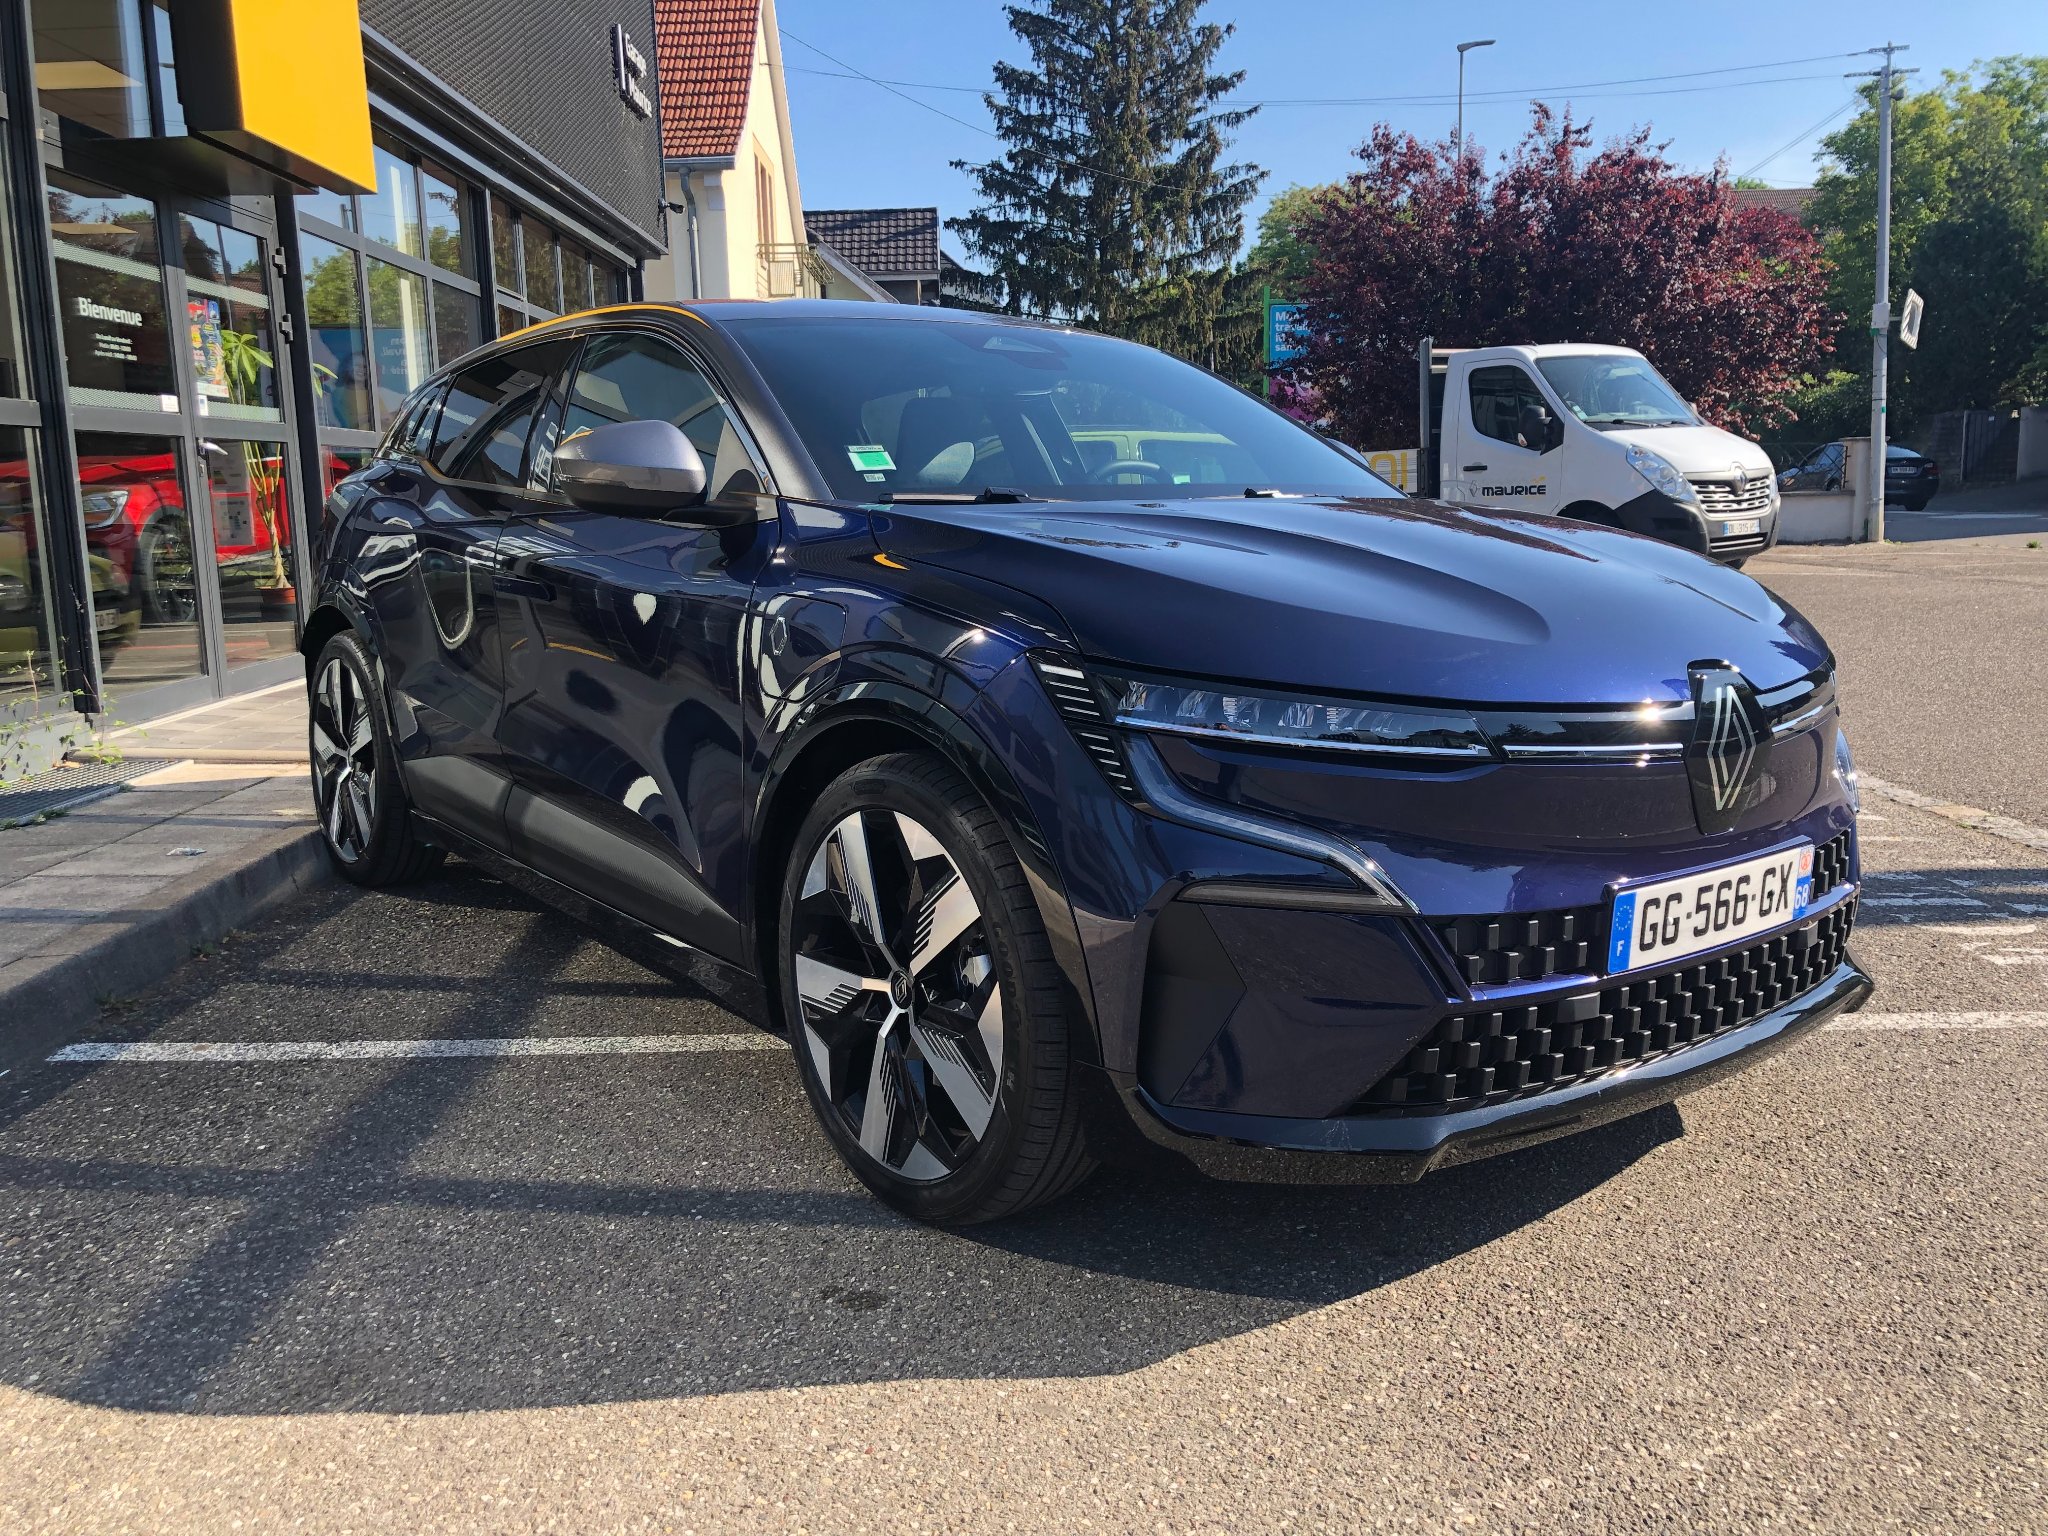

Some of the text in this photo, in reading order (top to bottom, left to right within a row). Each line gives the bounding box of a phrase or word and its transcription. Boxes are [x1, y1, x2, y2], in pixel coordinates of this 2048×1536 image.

[78, 297, 142, 327] Bienvenue
[1616, 861, 1810, 957] F GG-566-GX 68
